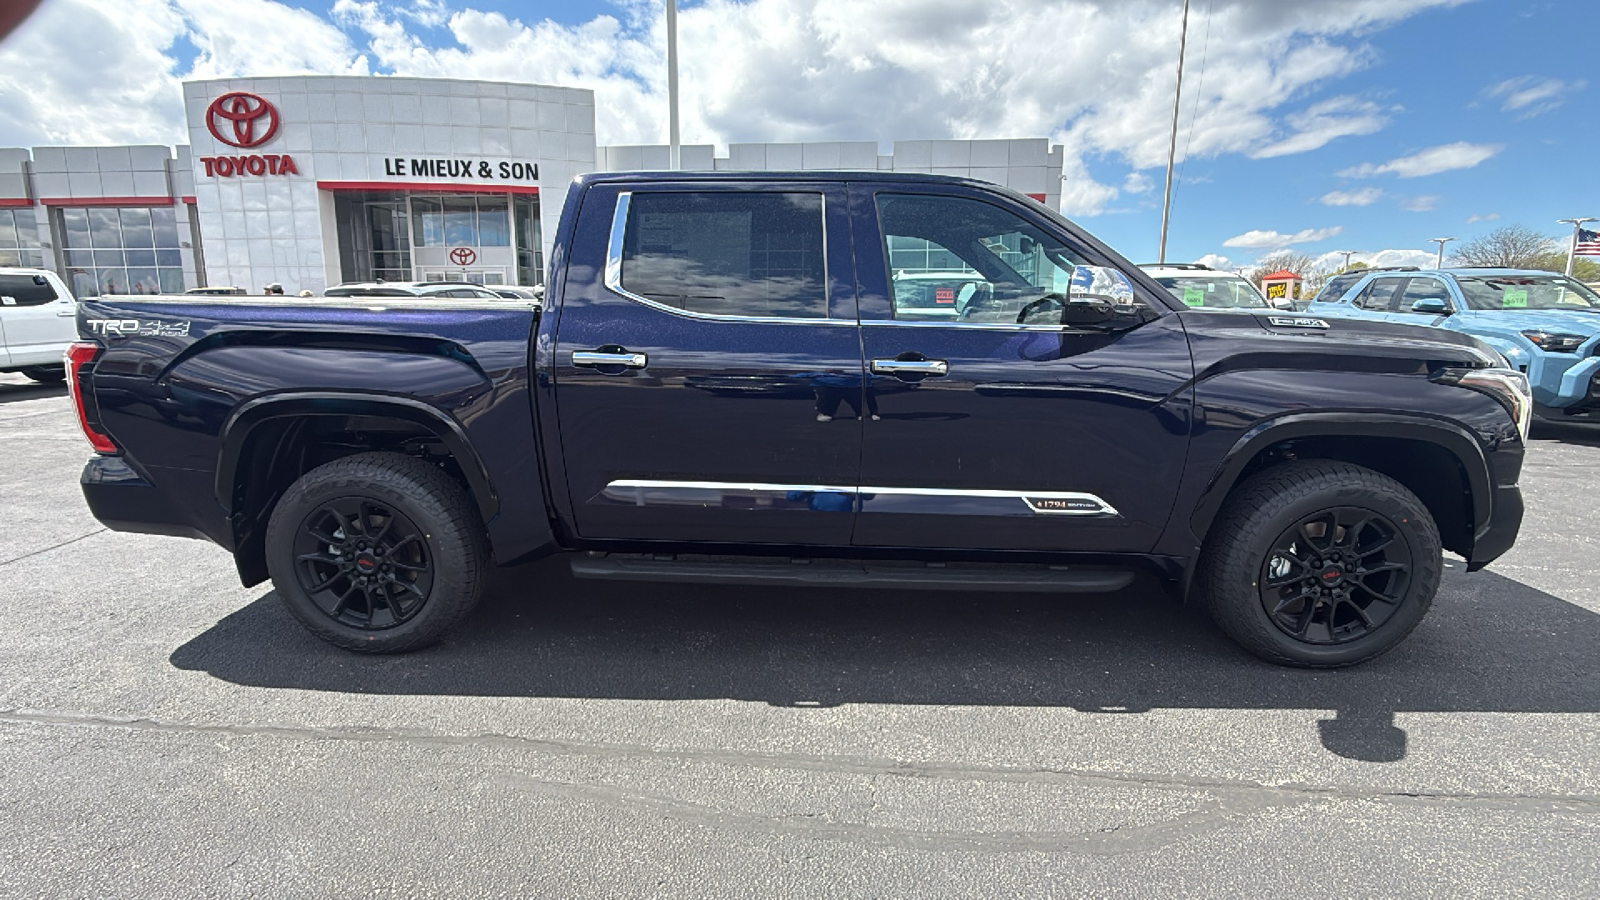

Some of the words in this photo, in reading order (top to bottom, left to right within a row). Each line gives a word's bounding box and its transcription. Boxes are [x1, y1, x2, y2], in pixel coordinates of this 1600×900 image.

[200, 155, 298, 177] TOYOTA
[385, 158, 406, 176] LE
[411, 159, 473, 178] MIEUX
[478, 161, 493, 178] &
[499, 161, 539, 180] SON
[87, 320, 140, 335] TRD
